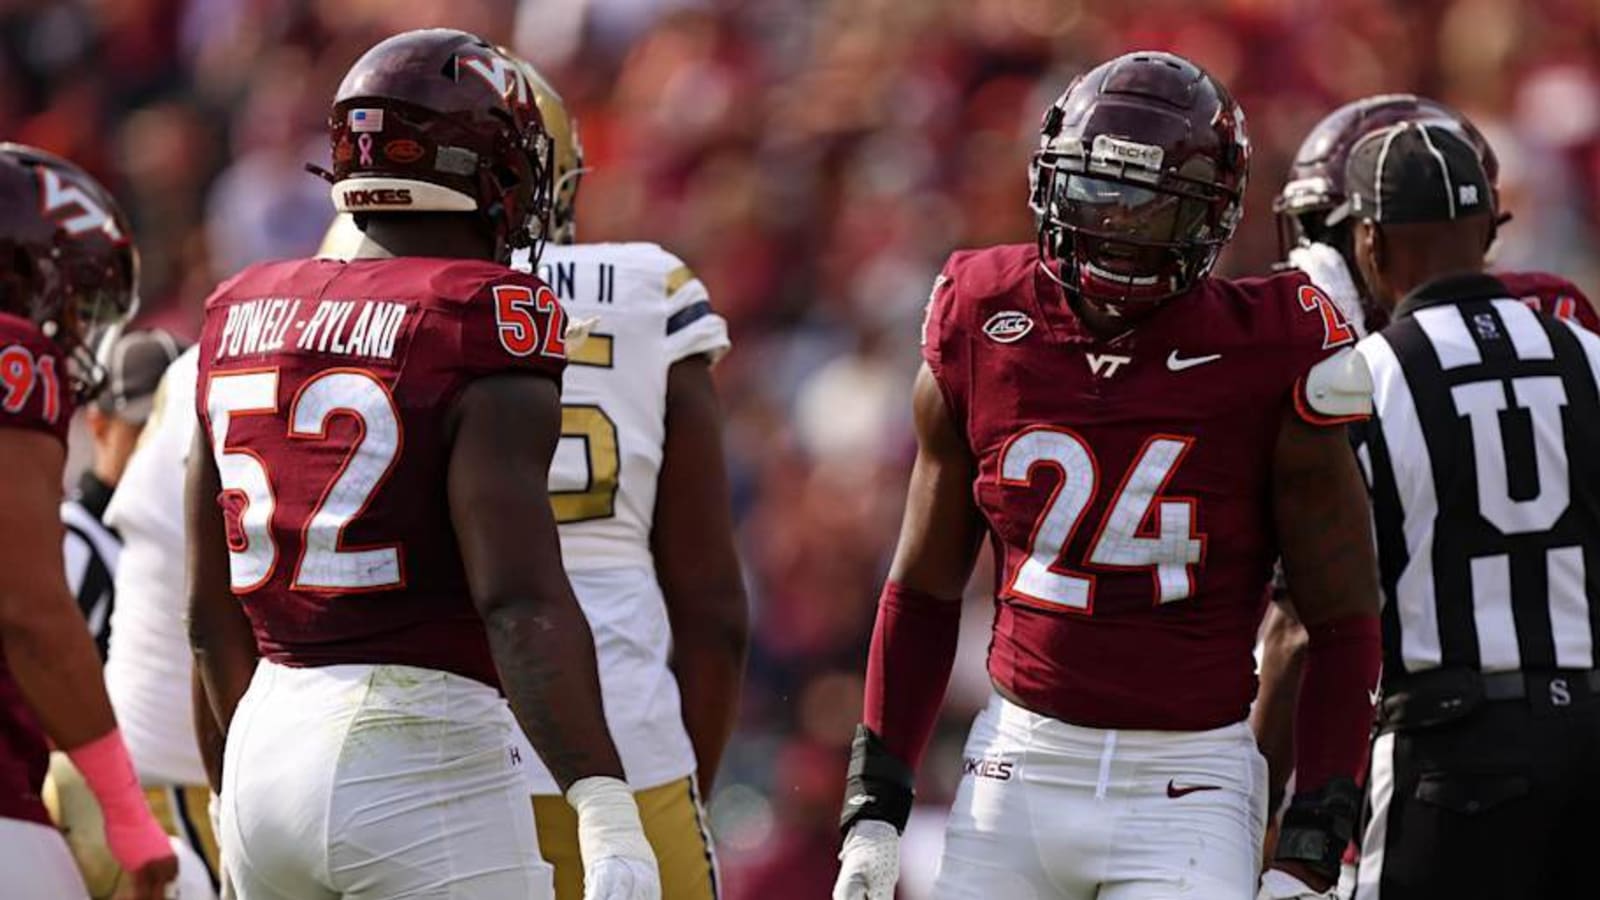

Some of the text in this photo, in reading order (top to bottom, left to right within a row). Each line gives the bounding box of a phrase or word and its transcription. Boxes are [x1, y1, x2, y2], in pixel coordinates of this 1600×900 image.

[36, 165, 130, 245] VT
[216, 298, 407, 358] POWELL-RYLAND
[492, 284, 566, 358] 52
[0, 345, 59, 423] 91
[1085, 352, 1132, 378] VT
[205, 366, 405, 594] 52
[1451, 376, 1569, 535] U
[997, 425, 1207, 615] 24
